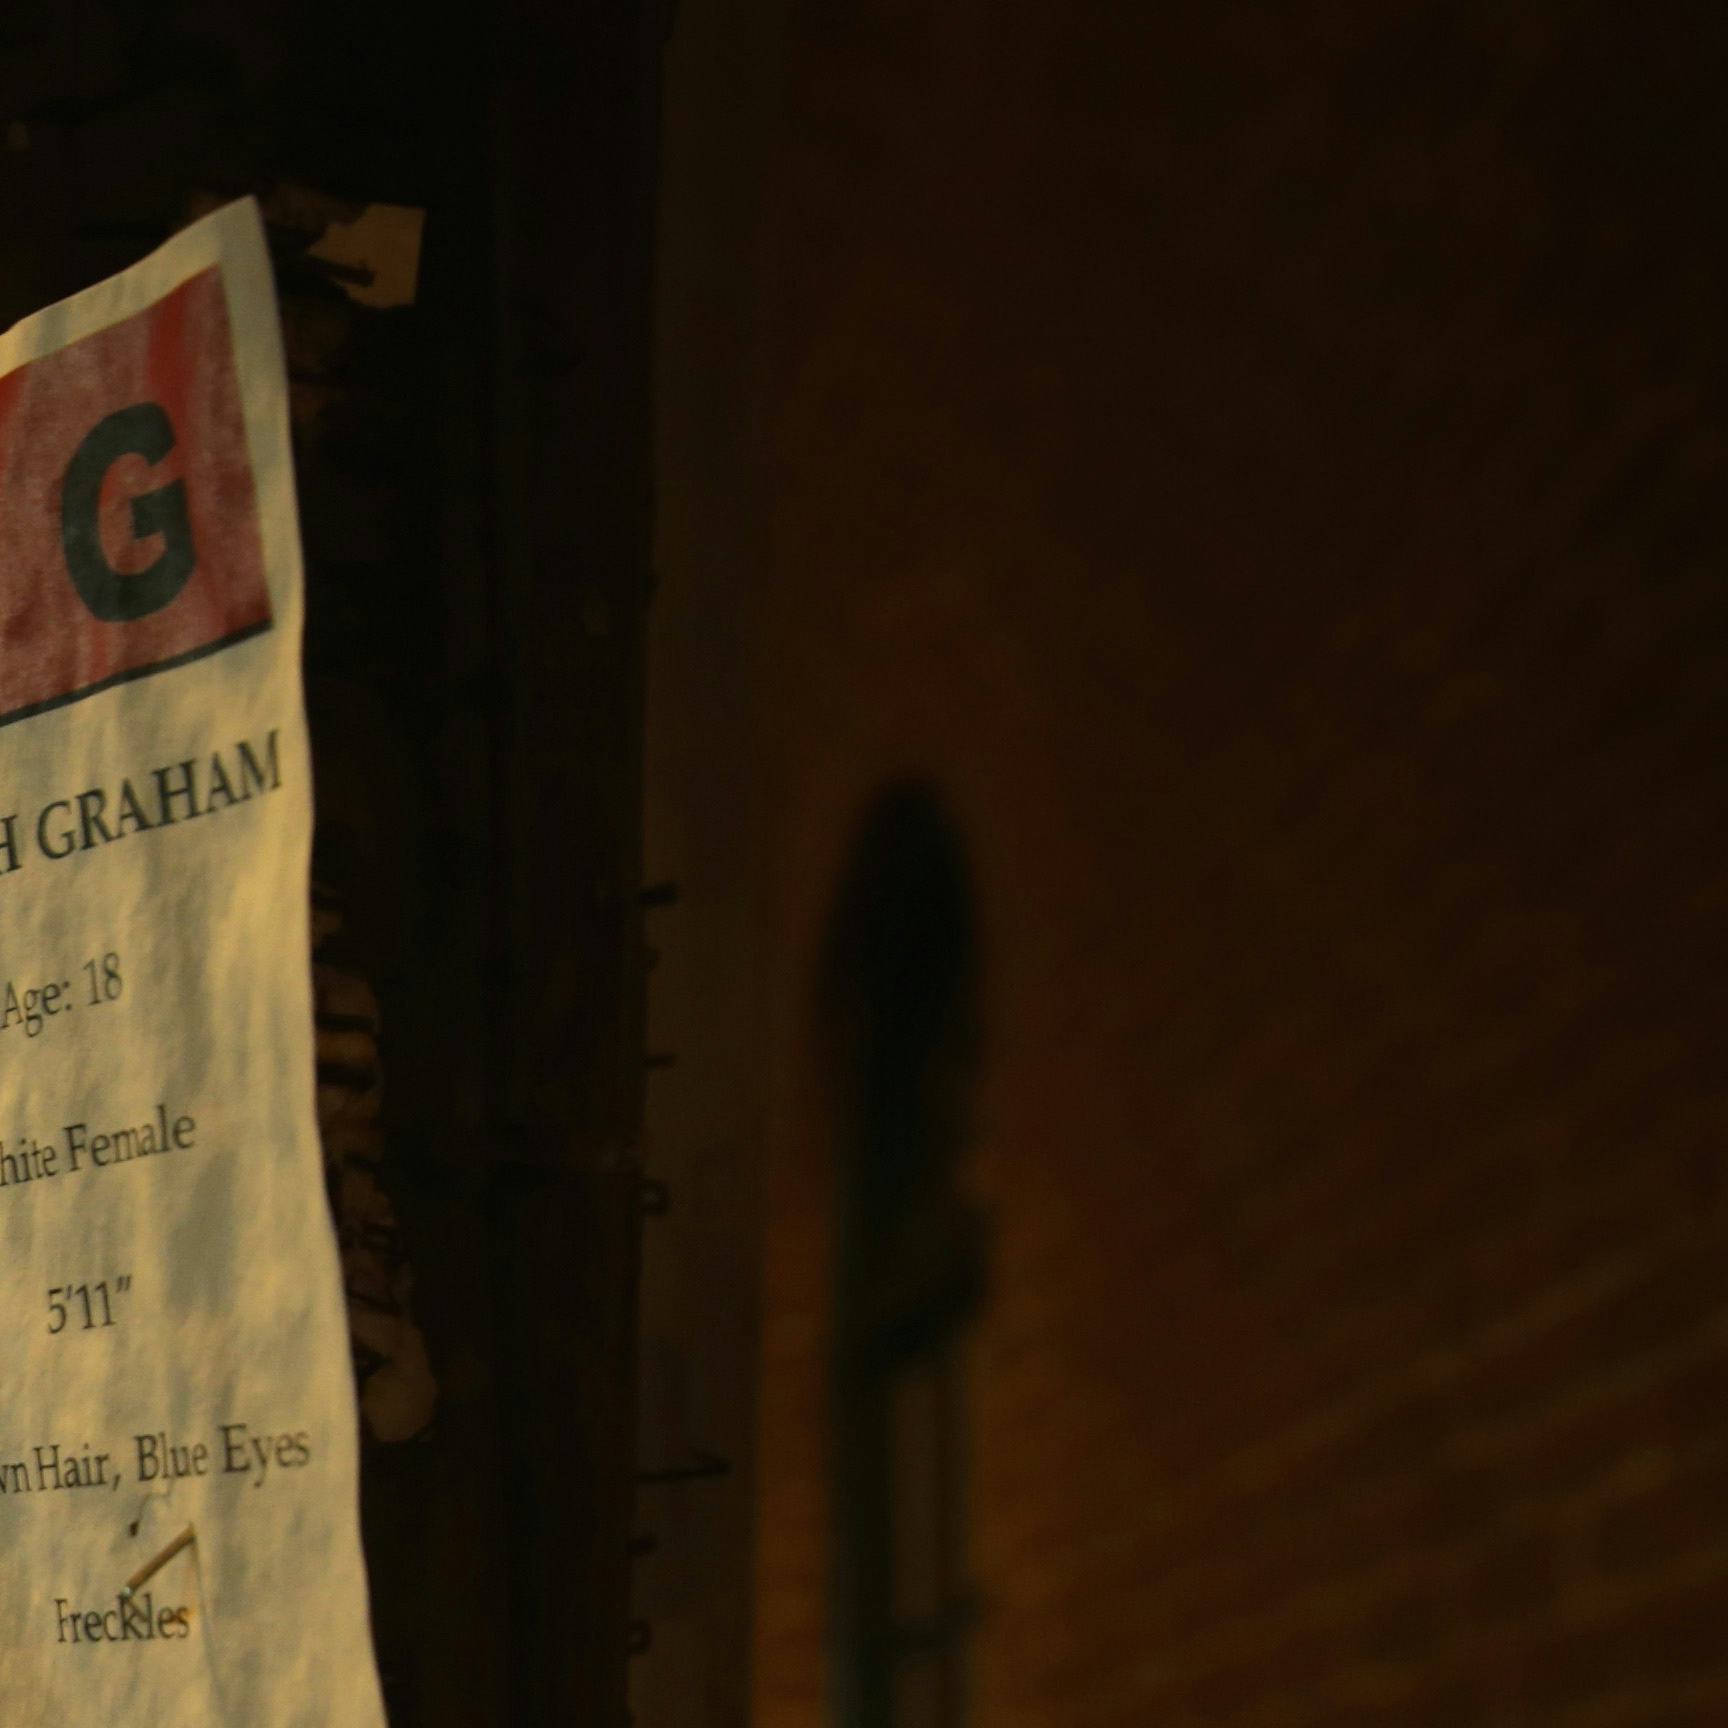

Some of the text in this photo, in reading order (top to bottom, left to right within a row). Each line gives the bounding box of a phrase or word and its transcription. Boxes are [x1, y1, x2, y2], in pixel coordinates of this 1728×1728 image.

[36, 729, 282, 861] GRAHAM
[0, 952, 124, 1037] Age: 18
[64, 1104, 196, 1172] Female
[33, 1444, 120, 1492] Hair,
[133, 1432, 209, 1482] Blue
[218, 1423, 312, 1488] Eyes
[54, 1593, 191, 1643] Freckles
